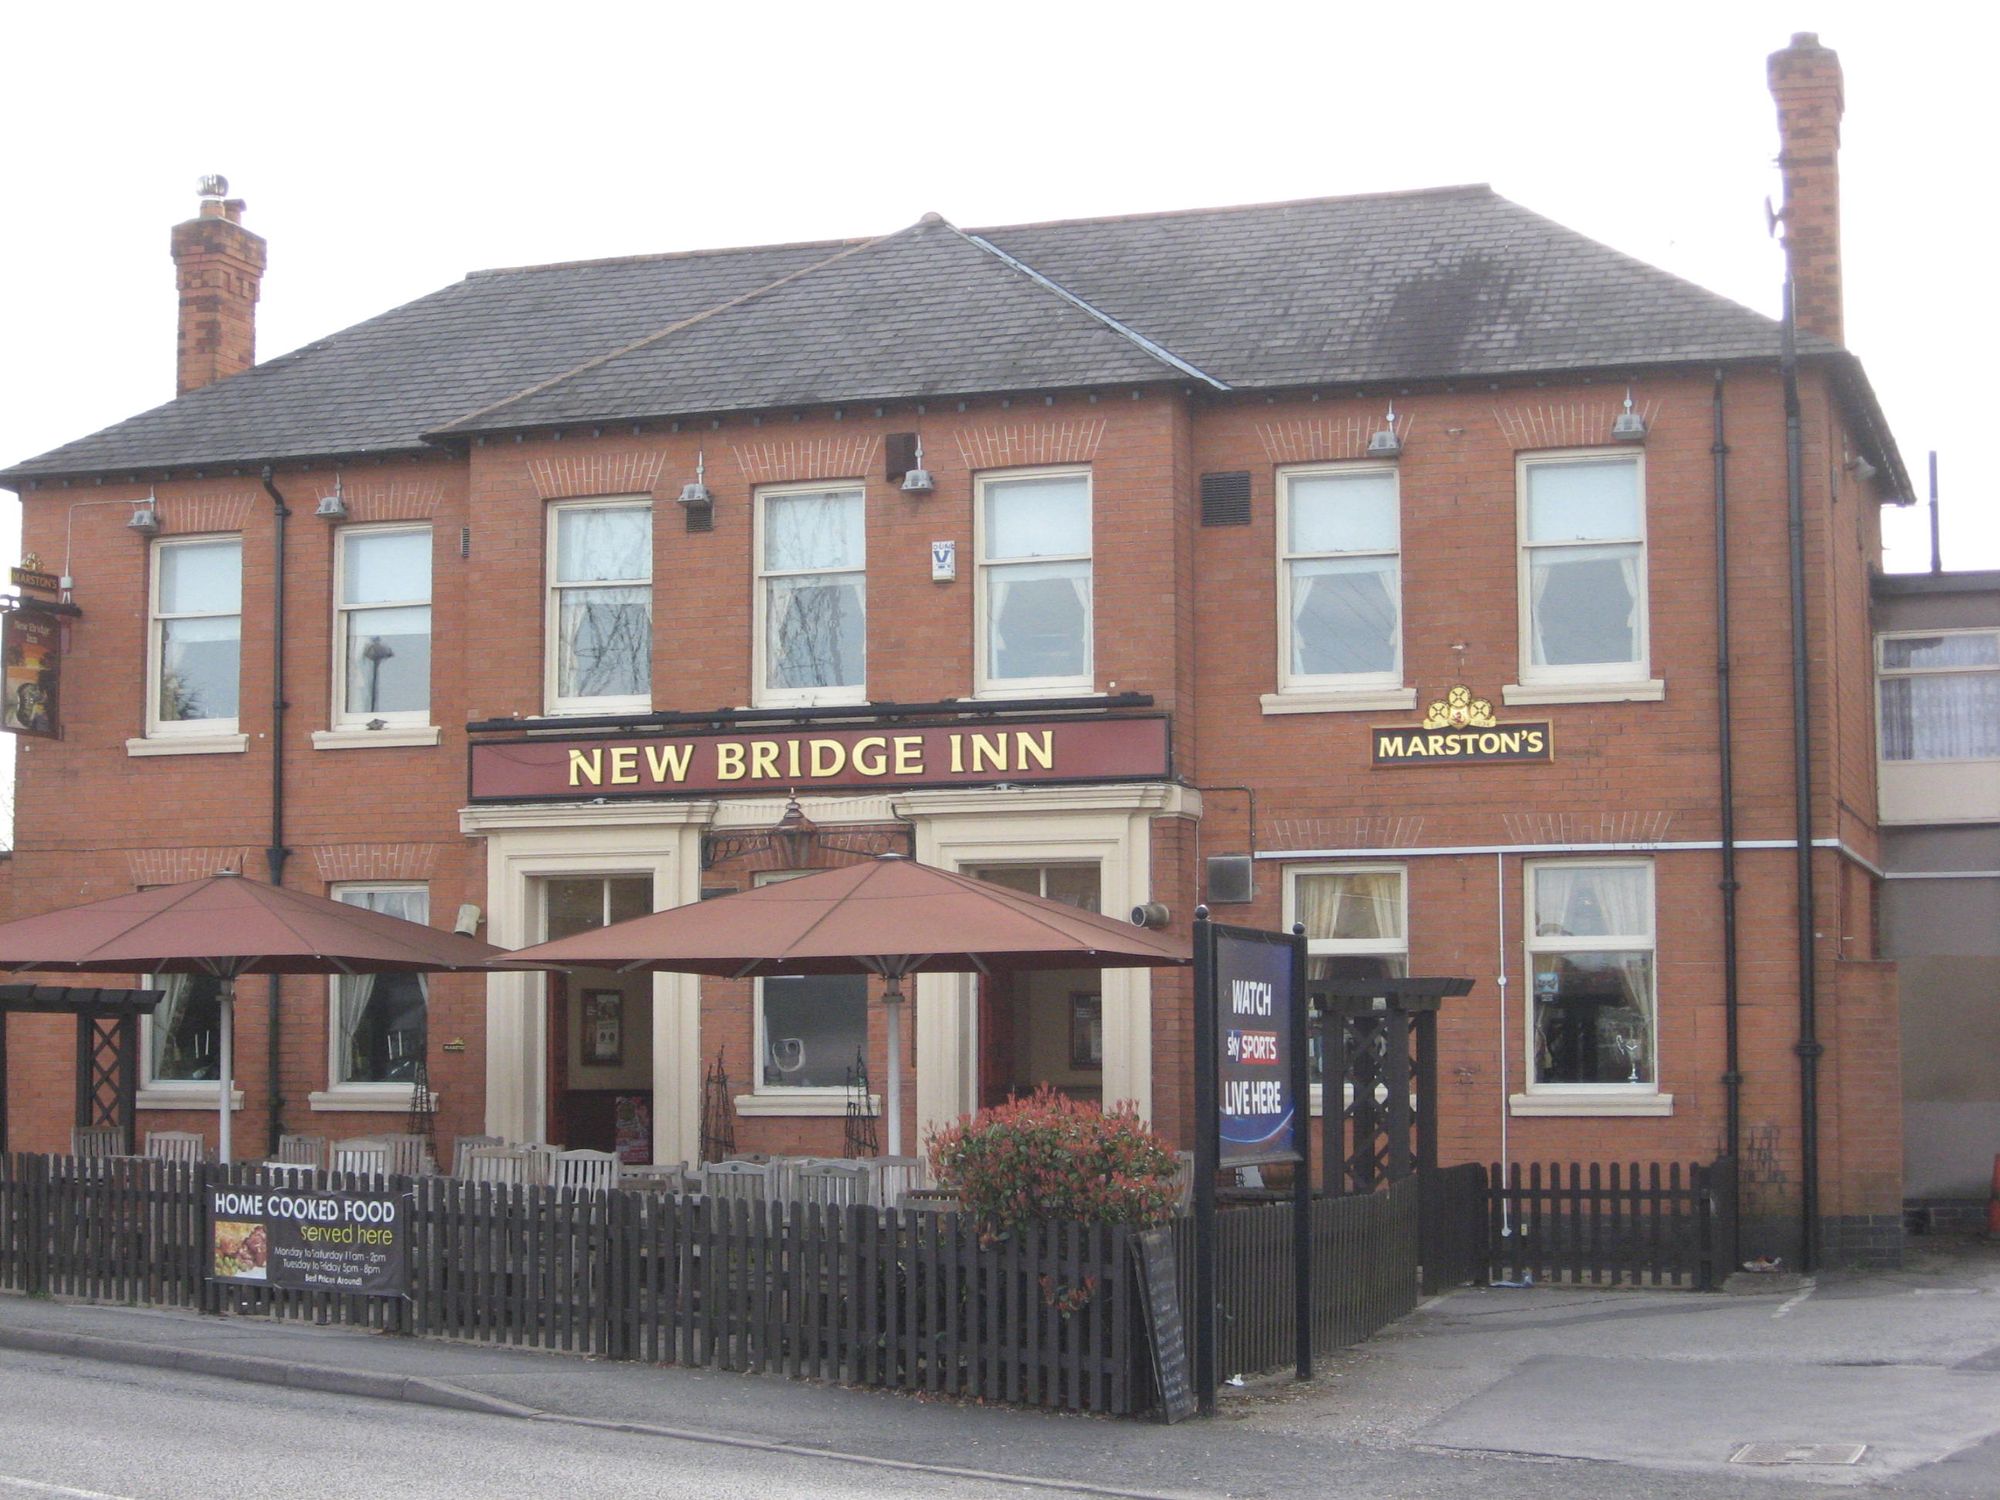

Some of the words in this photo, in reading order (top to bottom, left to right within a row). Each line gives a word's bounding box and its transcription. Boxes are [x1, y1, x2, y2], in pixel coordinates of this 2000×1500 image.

[568, 744, 694, 786] NEW
[716, 736, 924, 780] BRIDGE
[949, 731, 1053, 773] INN
[1378, 730, 1544, 758] MARSTON'S
[1232, 979, 1272, 1016] WATCH
[1227, 1030, 1240, 1062] sky
[1242, 1035, 1277, 1060] SPORTS
[1225, 1081, 1250, 1116] LIVE
[1251, 1080, 1282, 1115] HERE
[215, 1193, 263, 1216] HOME
[267, 1195, 339, 1221] COOKED
[344, 1200, 395, 1223] FOOD
[300, 1224, 353, 1243] served
[357, 1224, 393, 1245] here
[274, 1246, 303, 1258] Monday
[283, 1258, 310, 1271] Tuesday
[305, 1273, 317, 1282] Best
